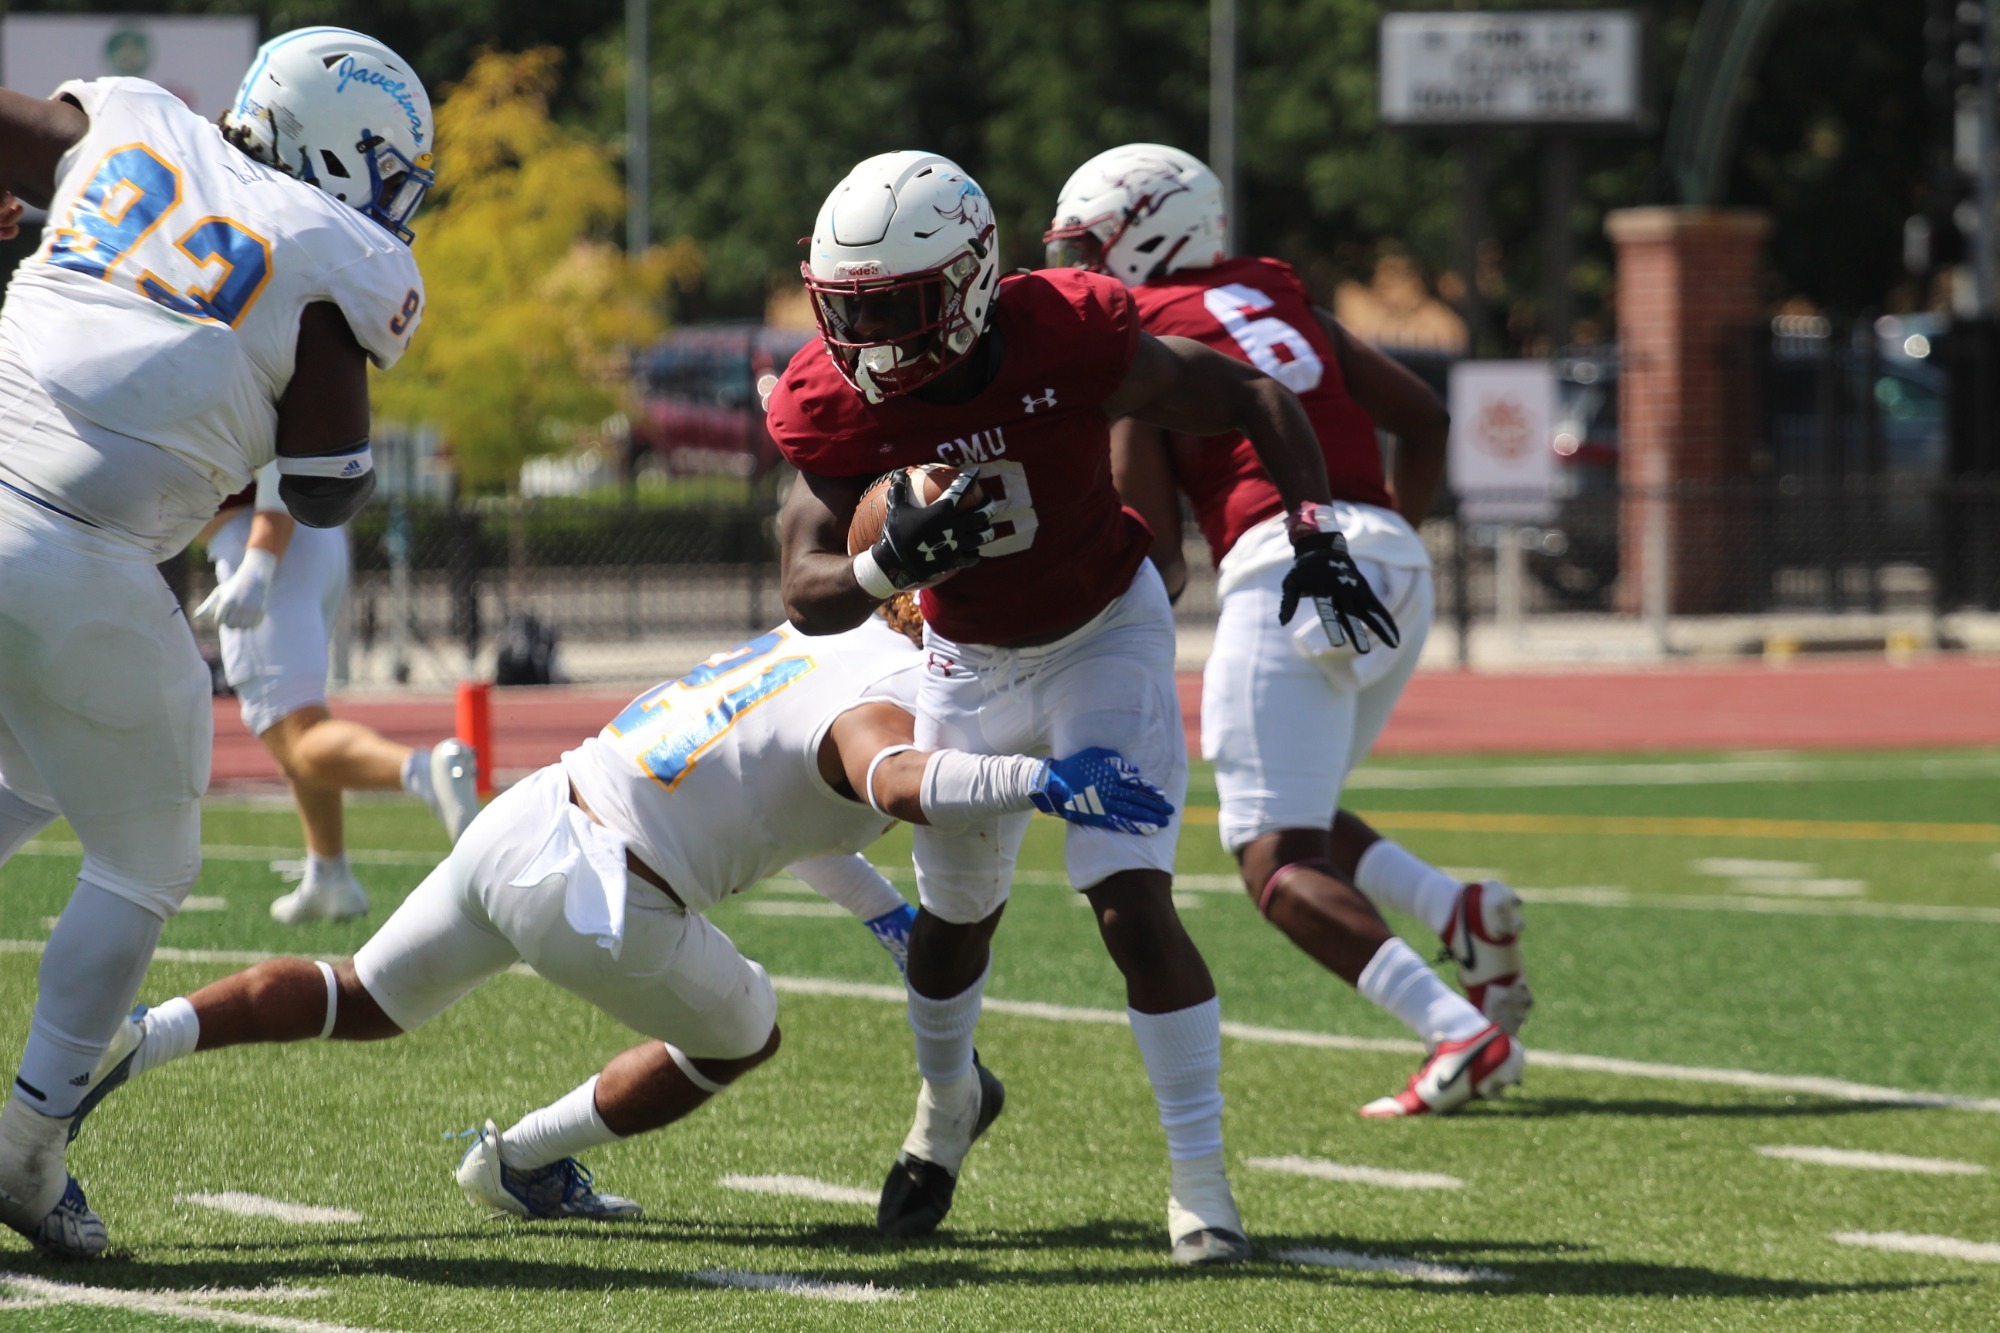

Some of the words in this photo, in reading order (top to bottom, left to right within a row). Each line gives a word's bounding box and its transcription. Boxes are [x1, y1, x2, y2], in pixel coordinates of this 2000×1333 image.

[40, 141, 275, 331] 93
[389, 287, 426, 351] 9
[1204, 282, 1324, 394] 6
[936, 426, 1007, 465] CMU
